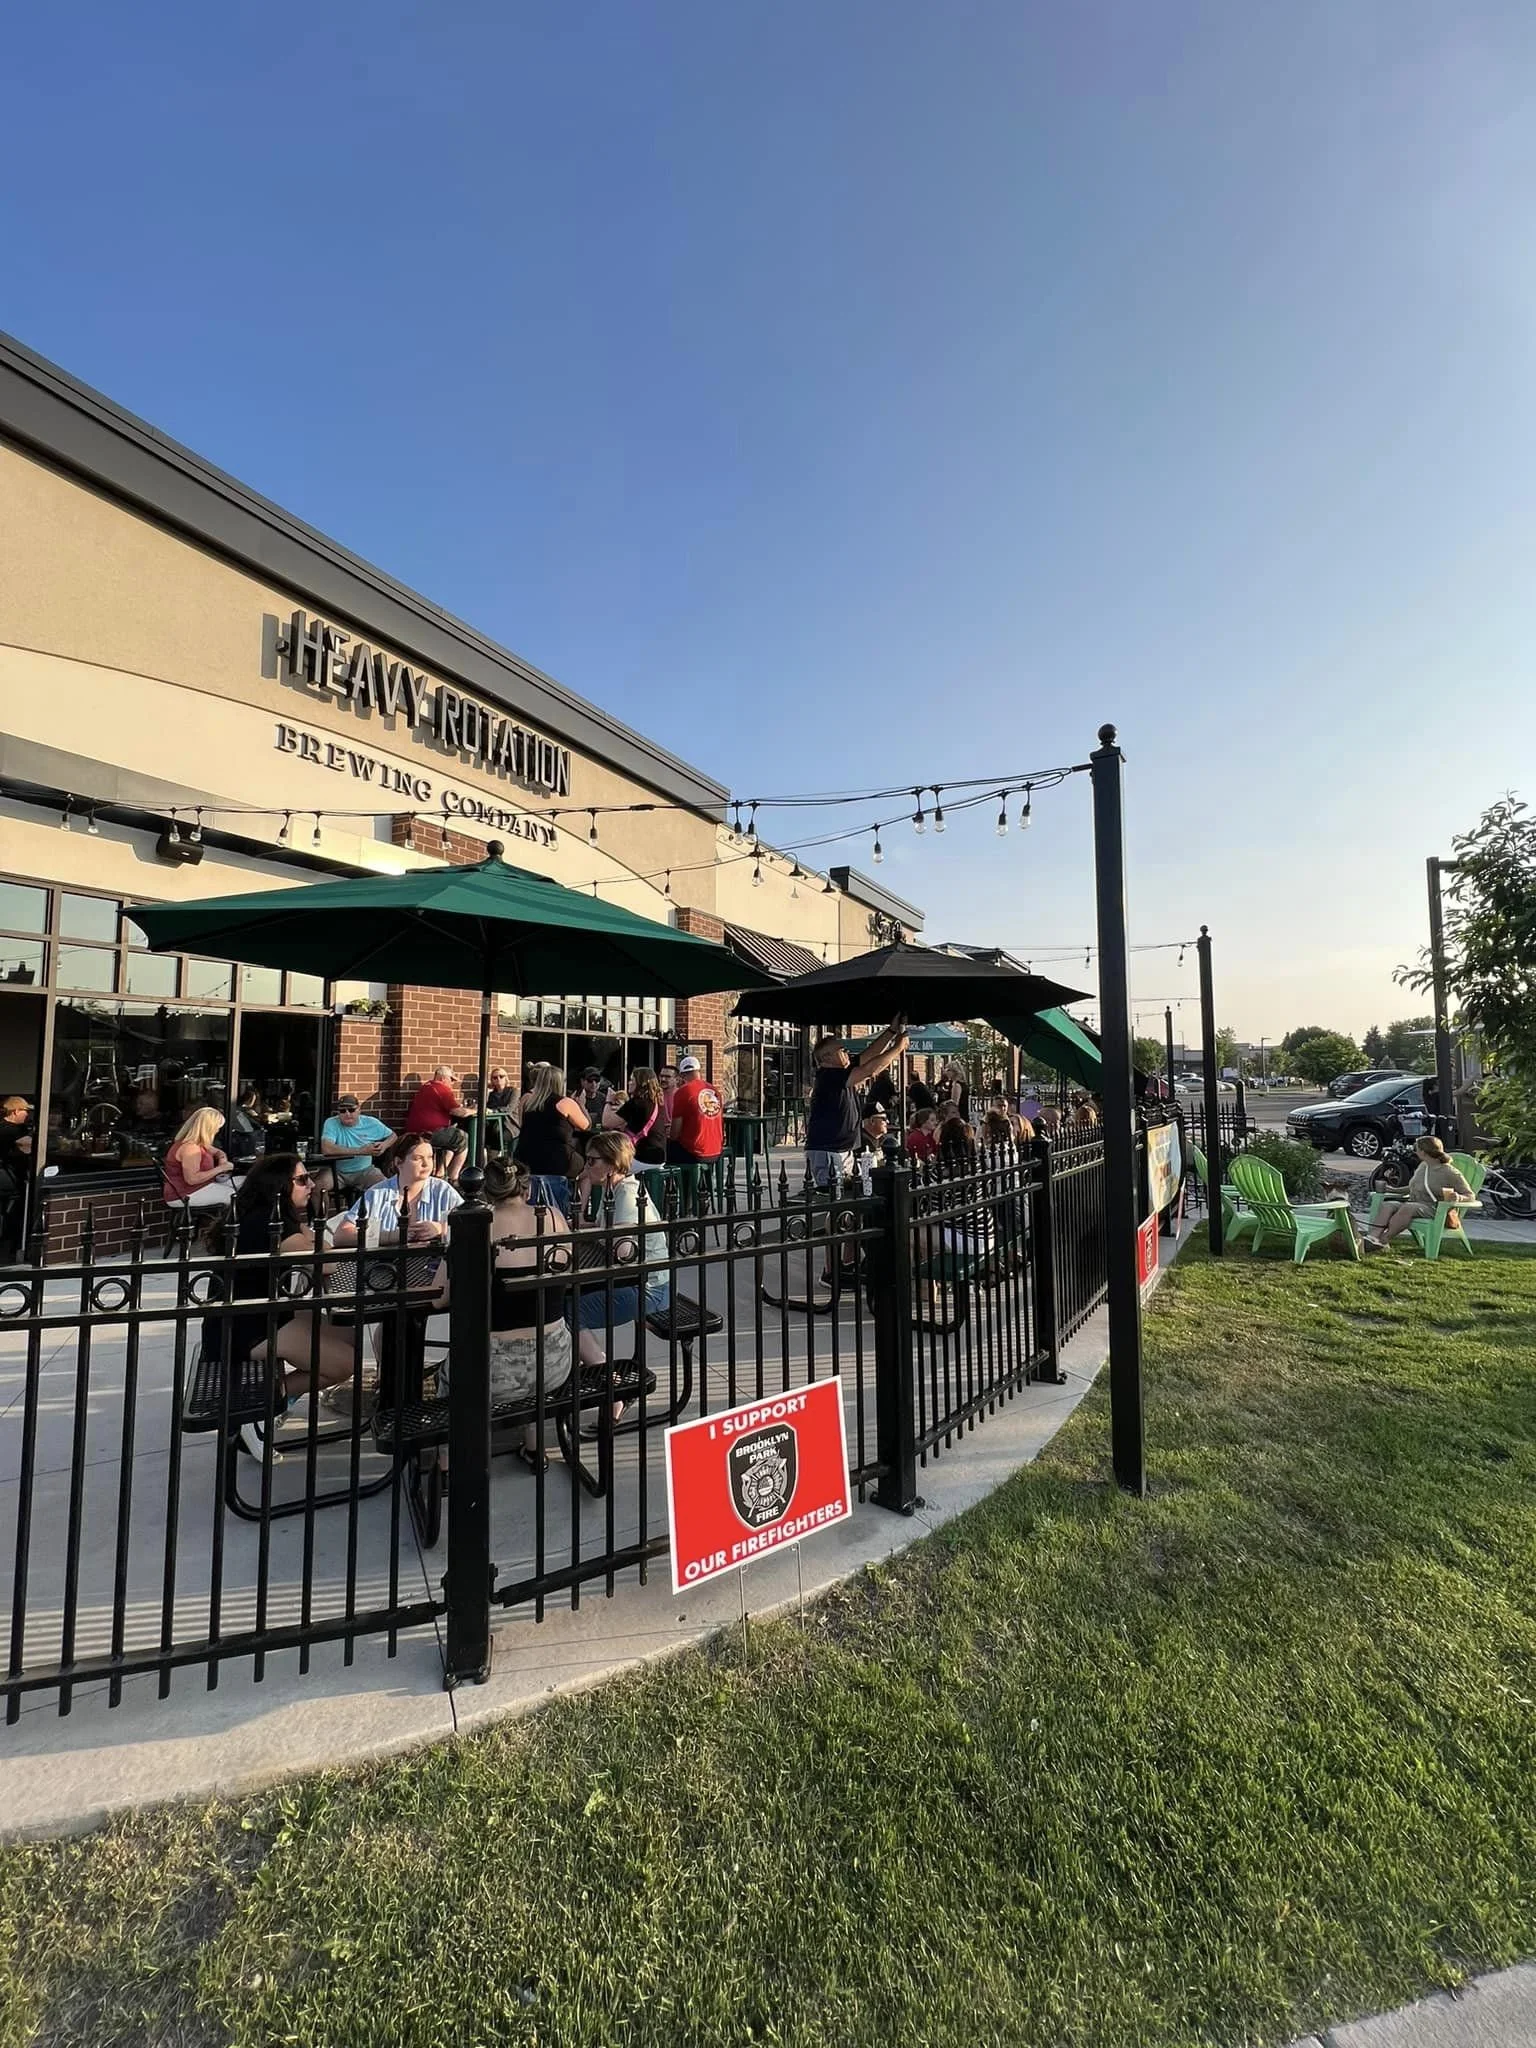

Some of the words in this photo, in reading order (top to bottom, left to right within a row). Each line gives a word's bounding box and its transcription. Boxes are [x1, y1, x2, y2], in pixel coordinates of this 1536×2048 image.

[288, 609, 428, 729] HEAVY
[431, 684, 571, 797] ROTATION
[273, 722, 432, 802] BREWING
[440, 789, 554, 849] COMPANY
[708, 1425, 716, 1440] I
[722, 1395, 807, 1436] SUPPORT
[735, 1432, 789, 1458] BROOKLYN
[749, 1447, 777, 1464] PARK
[755, 1506, 780, 1523] FIRE
[684, 1550, 727, 1580] OUR
[732, 1500, 844, 1560] FIREFIGHTERS
